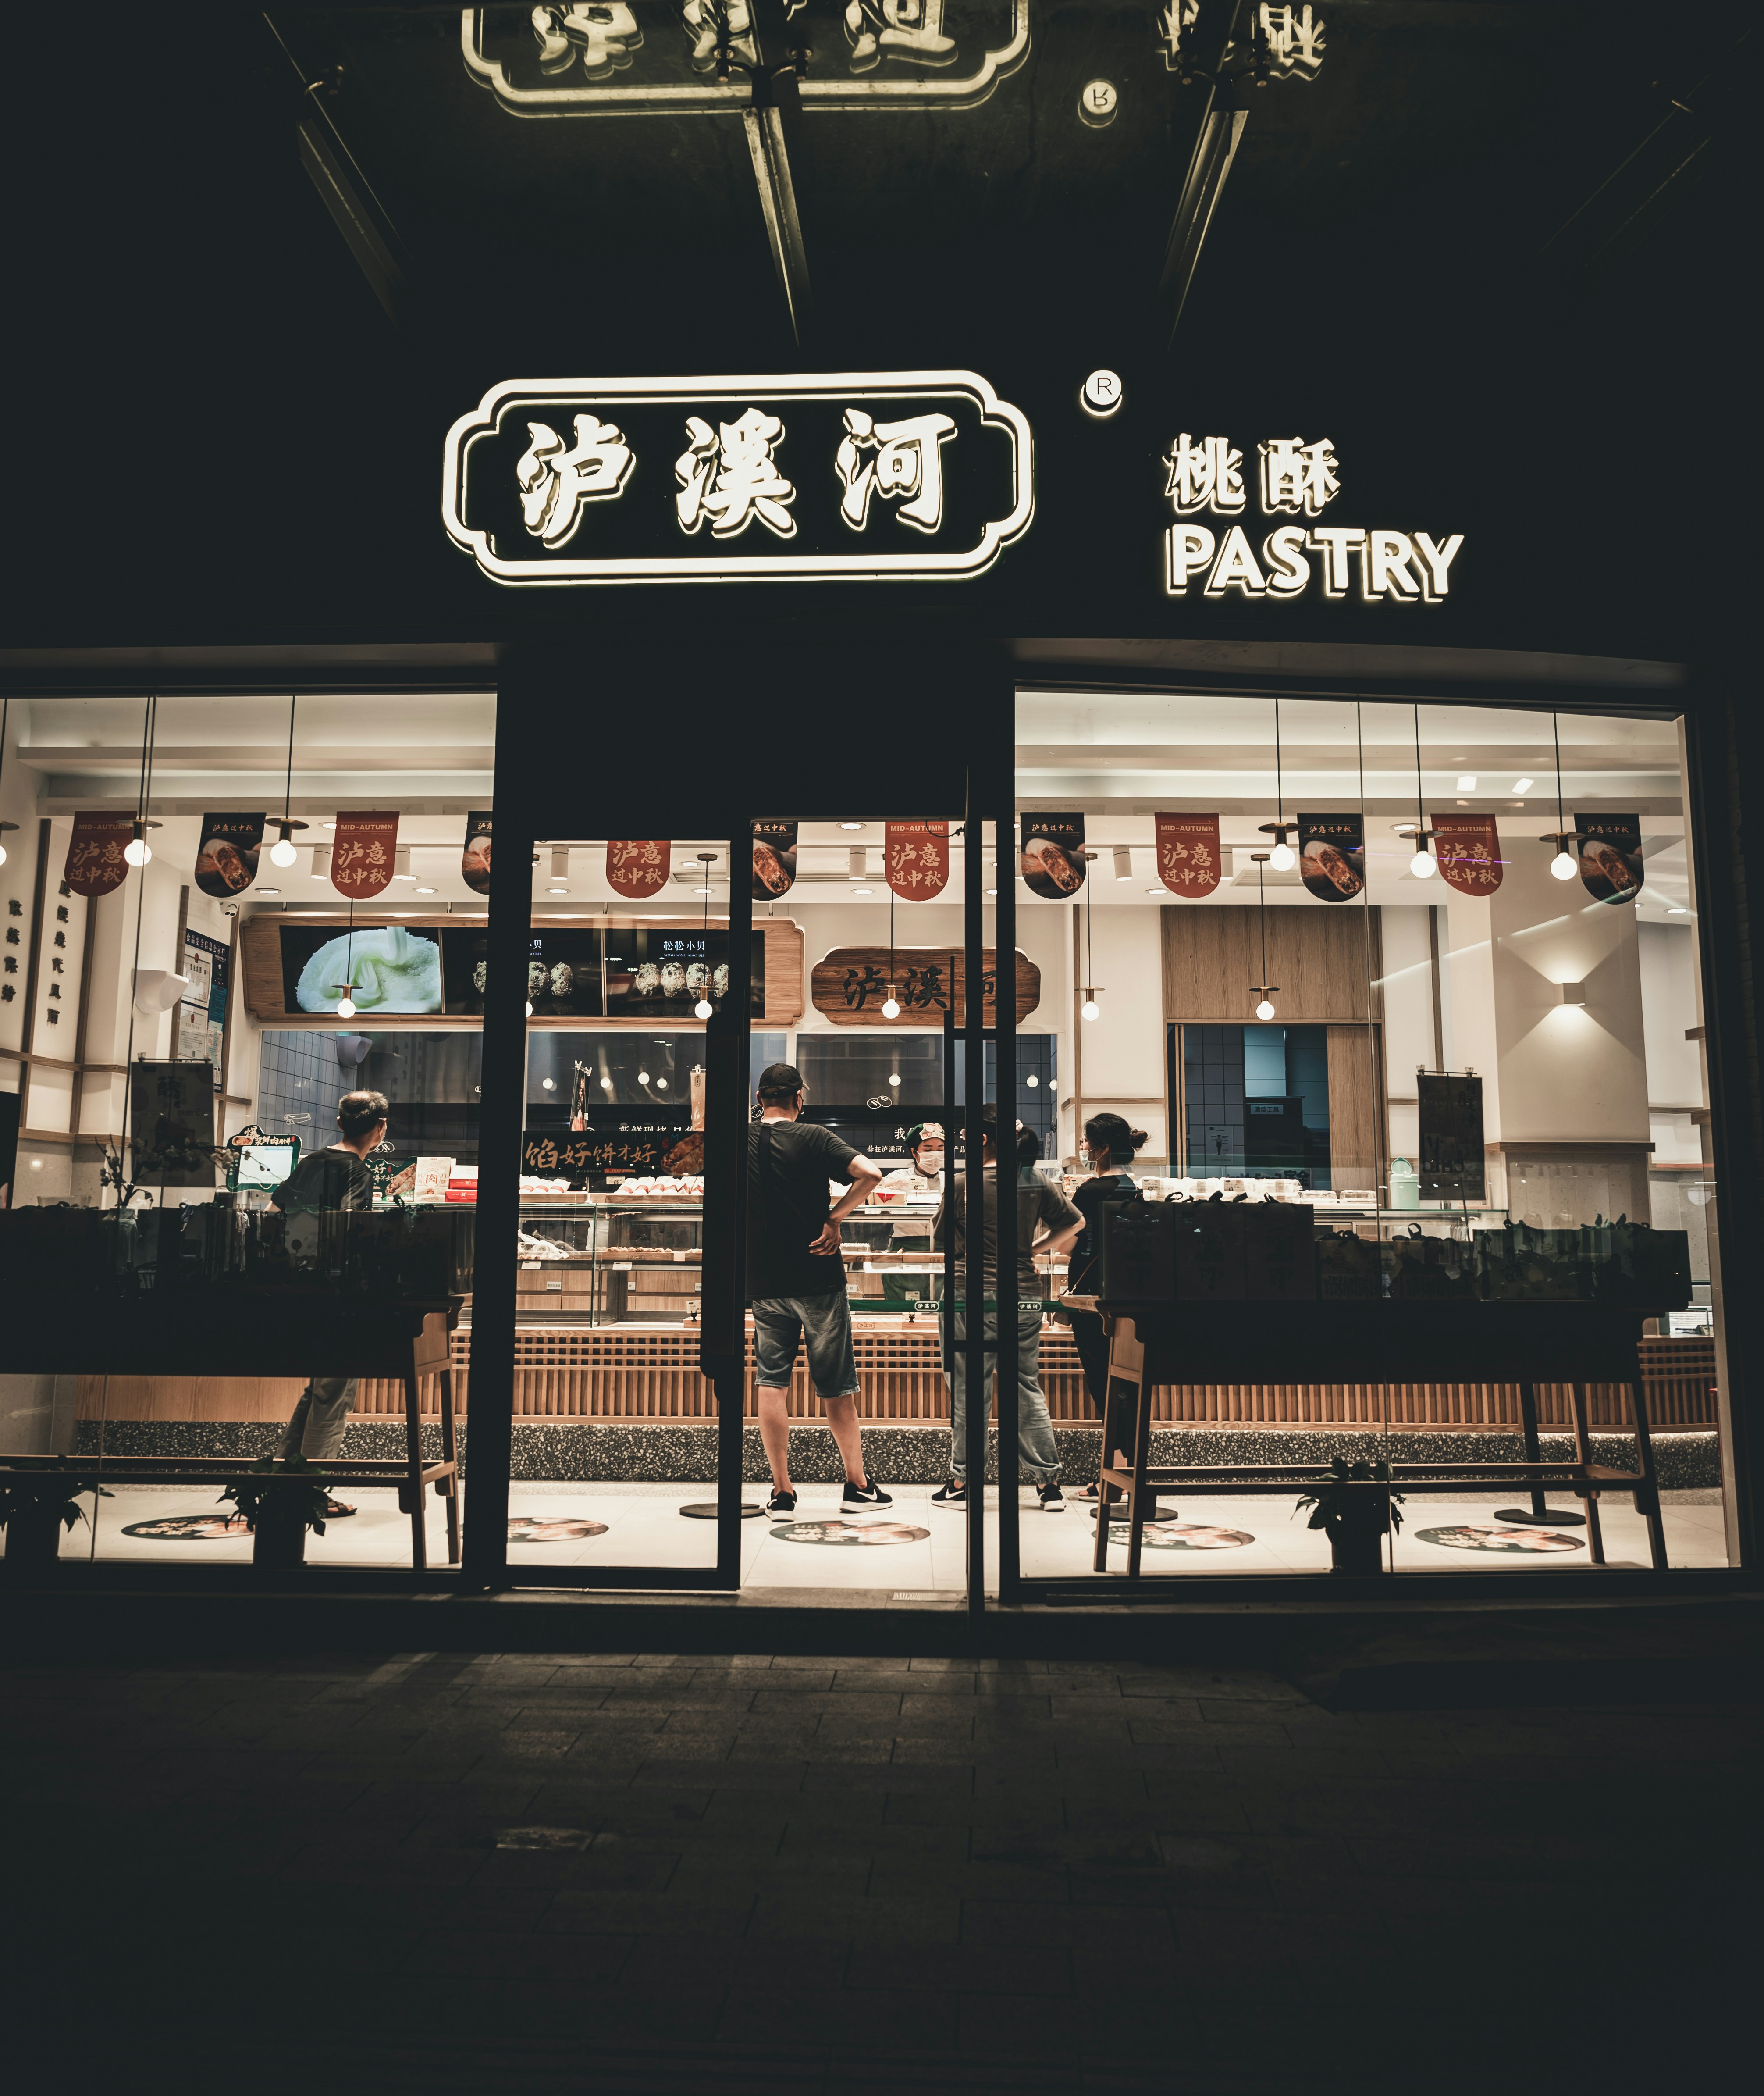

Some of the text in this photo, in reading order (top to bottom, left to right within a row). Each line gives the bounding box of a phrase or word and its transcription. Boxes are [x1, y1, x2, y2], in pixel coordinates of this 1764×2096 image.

[517, 408, 957, 548] 泸溪河
[1165, 433, 1340, 514] 桃酥
[1168, 524, 1464, 600] PASTRY
[1032, 823, 1074, 832] 泸意过中秋
[1309, 825, 1351, 834] 泸意过中秋
[1587, 824, 1629, 834] 泸意过中秋
[73, 841, 122, 865] 泸意
[338, 841, 387, 867] 泸意
[612, 841, 662, 867] 泸意
[891, 843, 941, 870] 泸意
[1163, 842, 1213, 867] 泸意
[1441, 842, 1493, 868] 泸意
[69, 868, 121, 883] 过中秋
[336, 868, 388, 885] 过中秋
[612, 868, 664, 884] 过中秋
[891, 870, 943, 888] 过中秋
[1164, 869, 1216, 886] 过中秋
[1446, 868, 1498, 885] 过中秋
[187, 933, 225, 956] 食品安全信息公示栏
[664, 941, 705, 951] 松松小贝
[526, 1138, 657, 1169] 馅好饼才好
[426, 1174, 438, 1184] 肉
